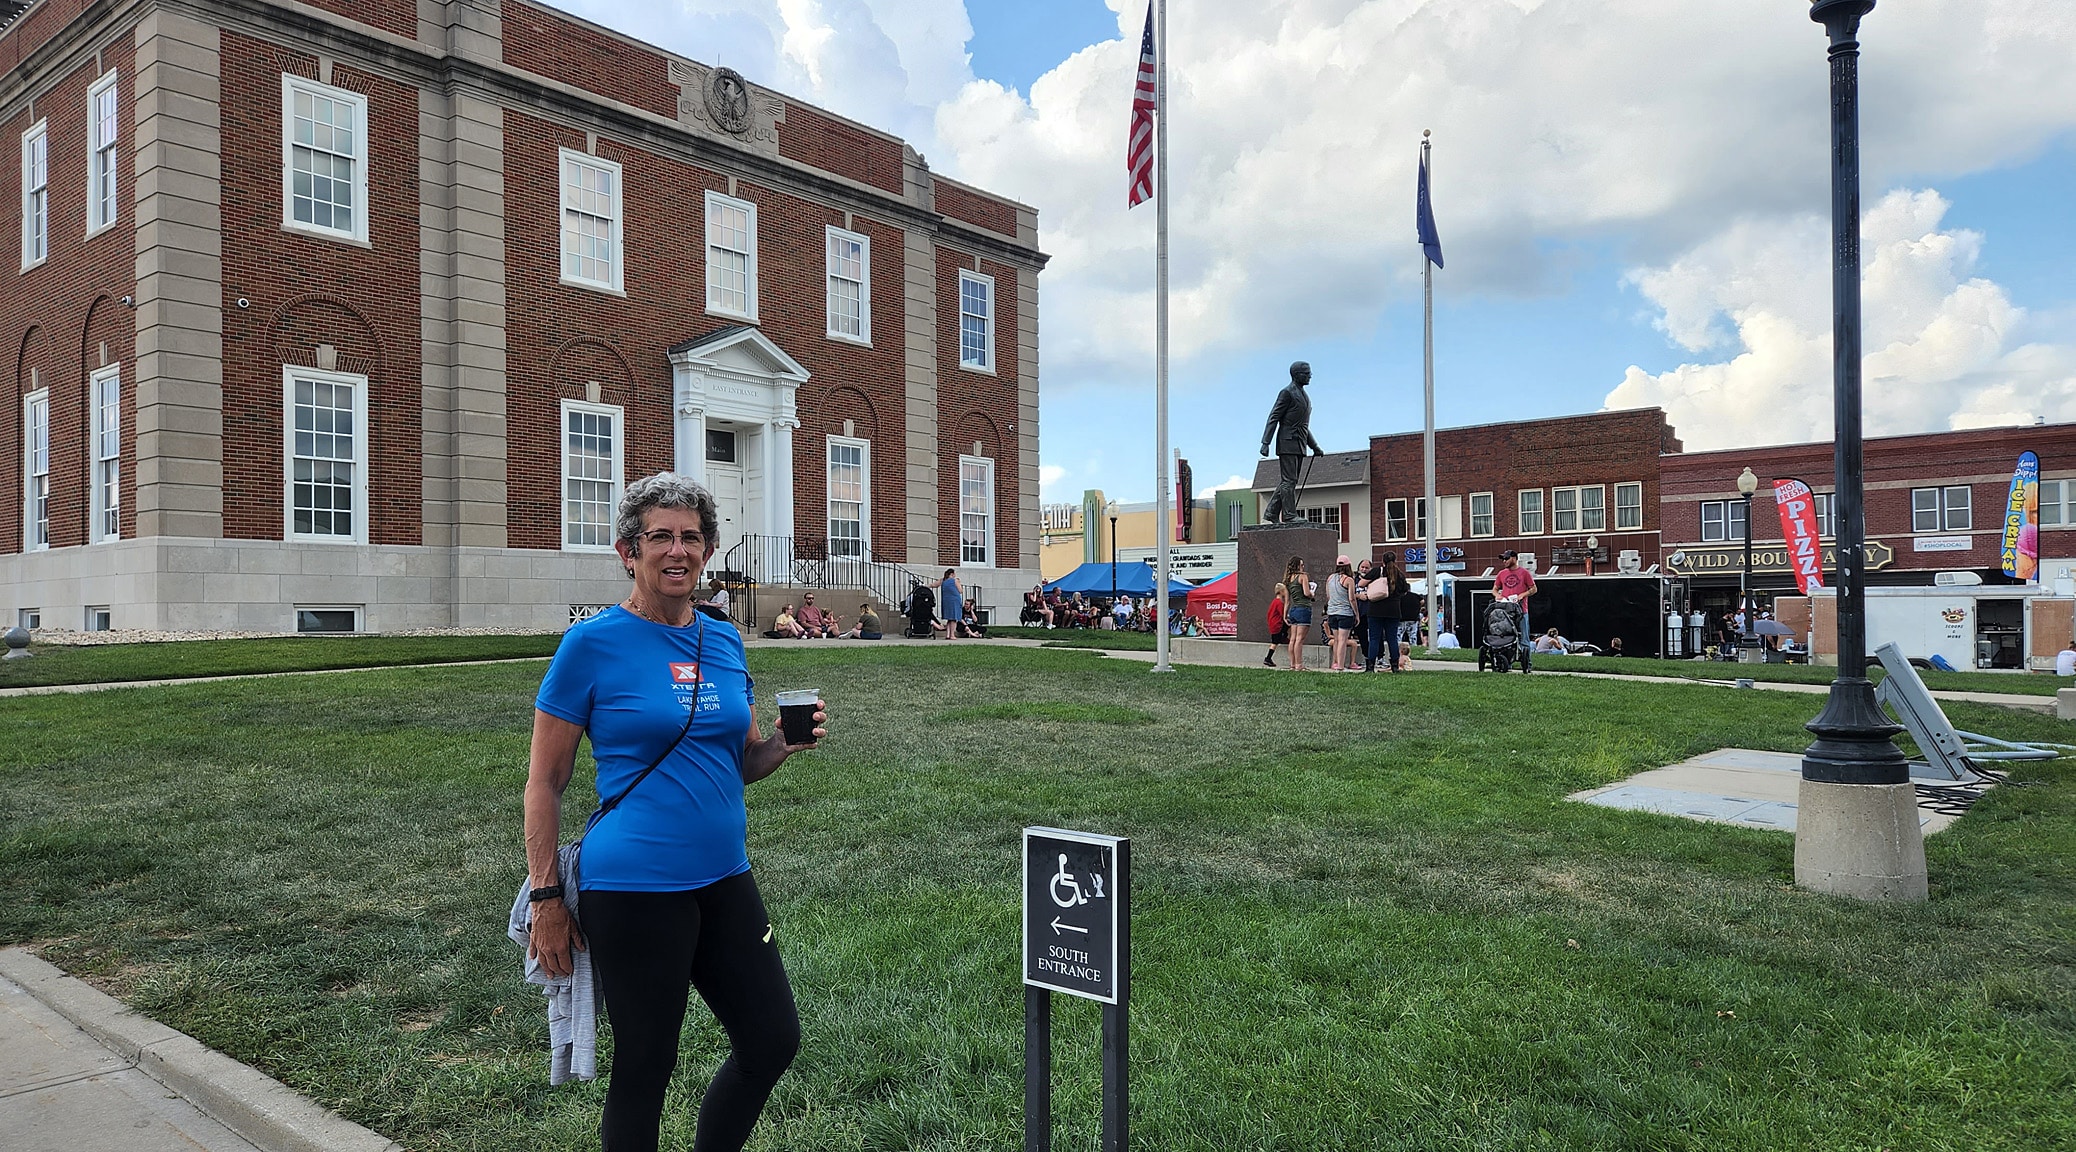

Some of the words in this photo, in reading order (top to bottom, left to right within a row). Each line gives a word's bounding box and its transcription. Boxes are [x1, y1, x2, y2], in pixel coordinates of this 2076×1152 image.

[728, 386, 759, 397] ENTRANCE
[1779, 487, 1805, 503] FRESH
[1780, 482, 1798, 494] HOT
[2010, 479, 2025, 512] ICE
[1786, 500, 1822, 588] PIZZA
[2002, 514, 2021, 571] CREAM
[1682, 554, 1730, 568] WILD
[1736, 552, 1789, 566] ABOU
[704, 702, 720, 711] RUN
[1049, 945, 1088, 964] SOUTH
[1038, 957, 1102, 982] ENTRANCE
